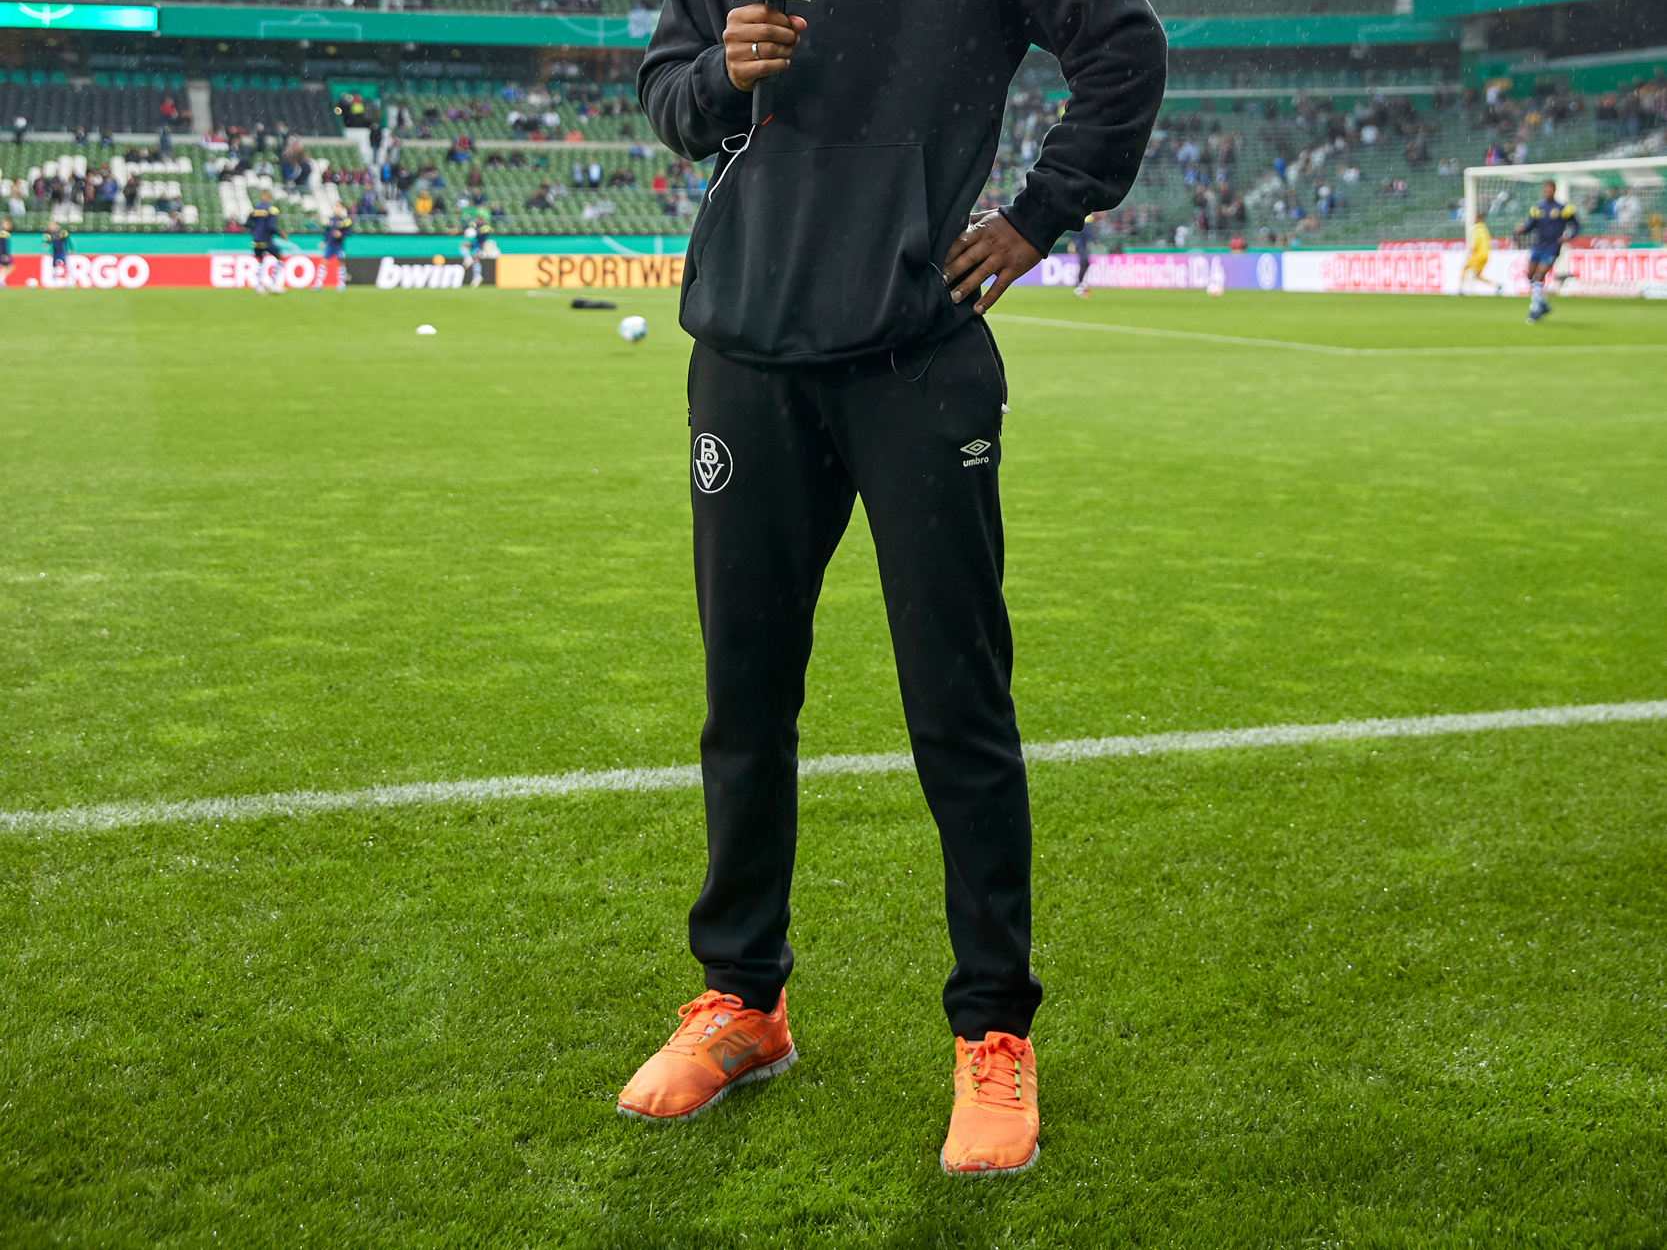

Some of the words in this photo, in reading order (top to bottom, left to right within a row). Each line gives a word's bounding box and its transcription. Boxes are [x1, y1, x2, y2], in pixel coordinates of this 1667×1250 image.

[39, 254, 150, 289] ERGO
[375, 255, 466, 289] bwin
[1333, 253, 1443, 290] BAUHAUS
[962, 456, 990, 468] umbro
